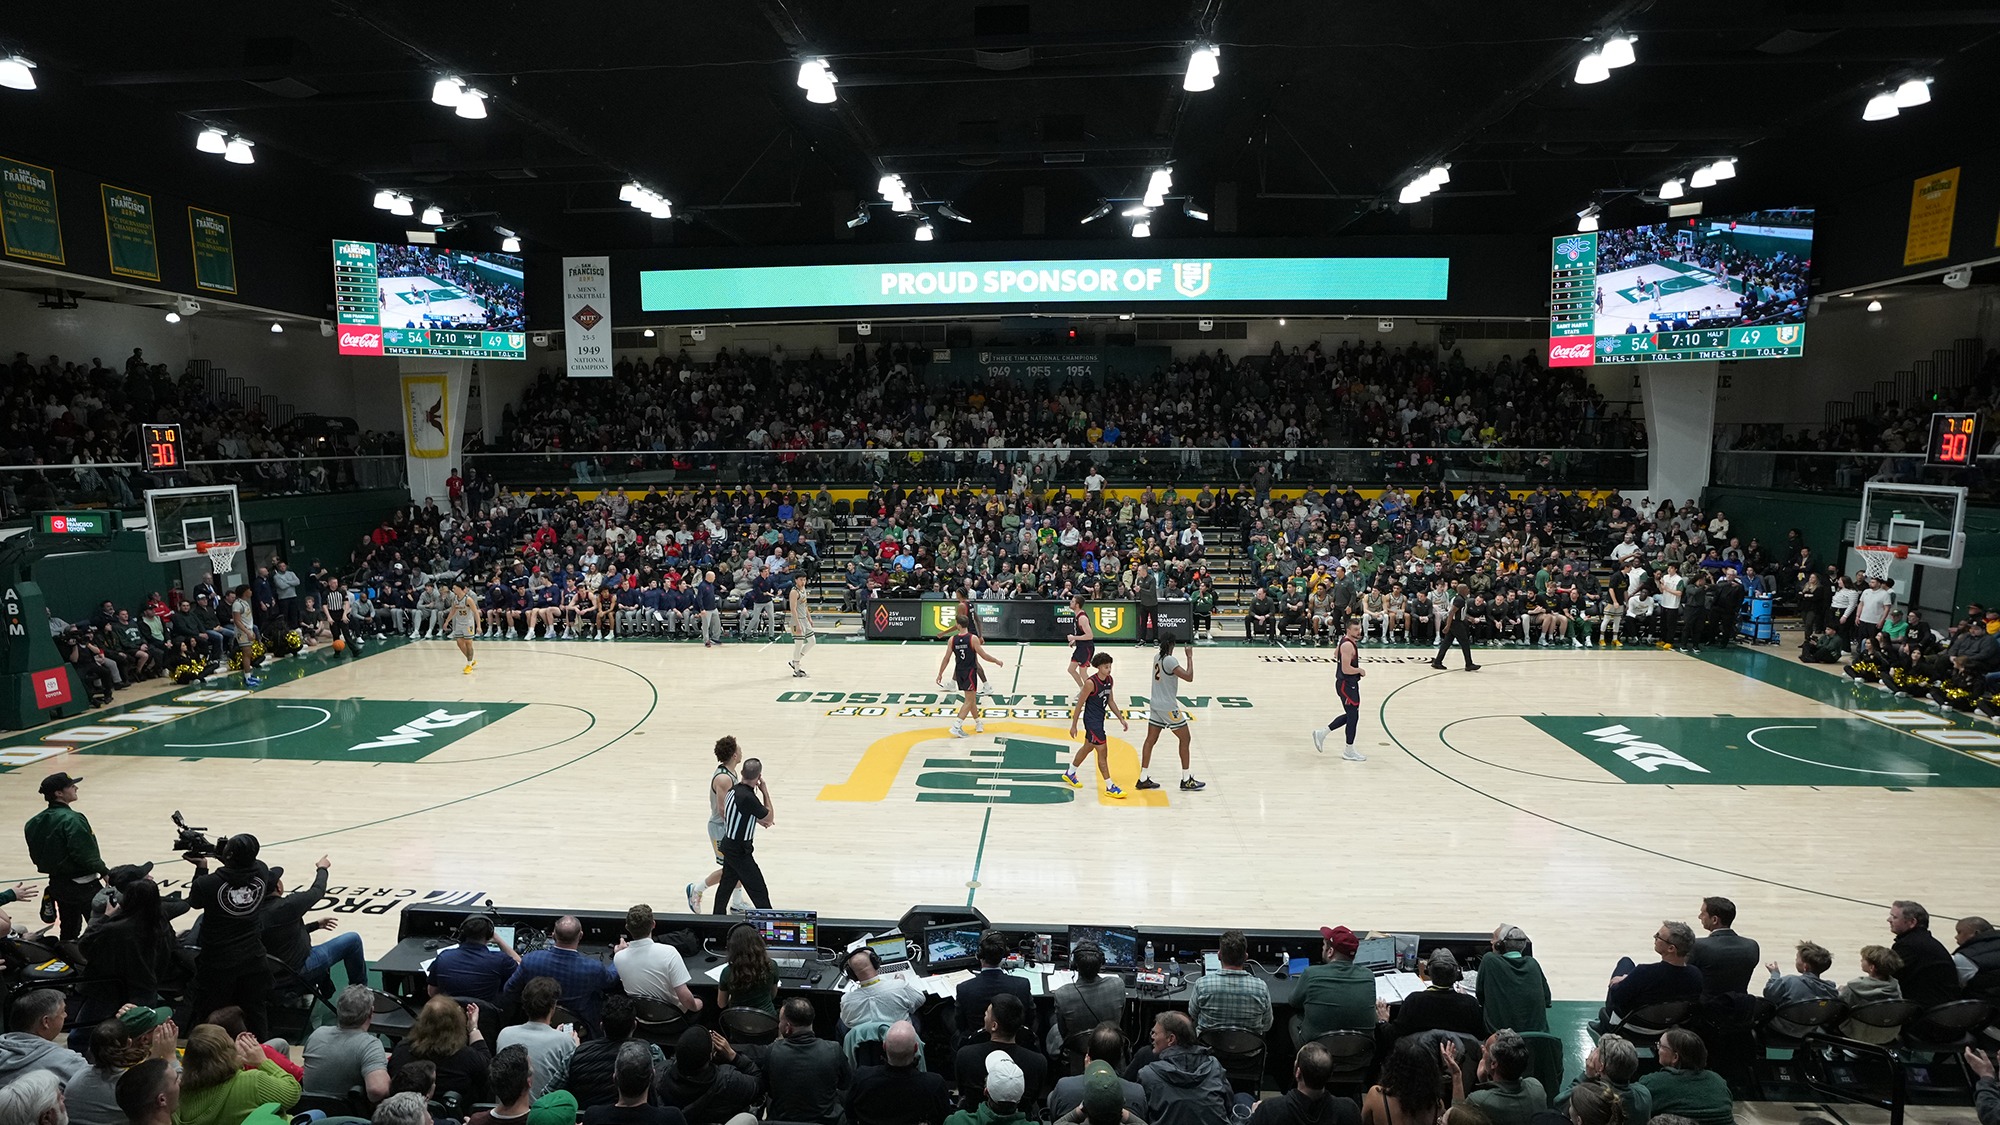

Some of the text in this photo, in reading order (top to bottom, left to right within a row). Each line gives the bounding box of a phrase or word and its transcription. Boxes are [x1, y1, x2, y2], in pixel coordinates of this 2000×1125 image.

[4, 170, 47, 190] FRANCISCO
[4, 191, 50, 207] CONFERENCE
[7, 199, 50, 214] CHAMPIONS
[110, 197, 145, 215] FRANCISCO
[196, 218, 224, 234] FRANCISCO
[568, 267, 605, 277] FRANCISCO
[881, 271, 978, 295] PROUD
[983, 268, 1119, 293] SPONSOR
[1123, 268, 1162, 291] OF
[567, 292, 607, 300] BASKETBALL
[340, 332, 380, 348] Coca-Cola
[408, 332, 422, 343] 54
[435, 333, 456, 343] 7:10
[488, 336, 502, 346] 49
[1631, 337, 1648, 350] 54
[1671, 333, 1700, 346] 7:10
[1712, 338, 1718, 346] 2
[1740, 330, 1760, 344] 49
[577, 346, 600, 355] 1949
[1550, 343, 1592, 359] Coca-Cola
[1699, 351, 1711, 359] TM
[987, 366, 1010, 377] 1949
[1026, 366, 1051, 377] 1955
[152, 429, 175, 442] 7:10
[1940, 433, 1968, 461] 30
[151, 443, 175, 466] 30
[959, 649, 966, 660] 3
[1154, 663, 1161, 681] 2
[45, 691, 62, 699] TOYOTA
[826, 705, 888, 717] OF
